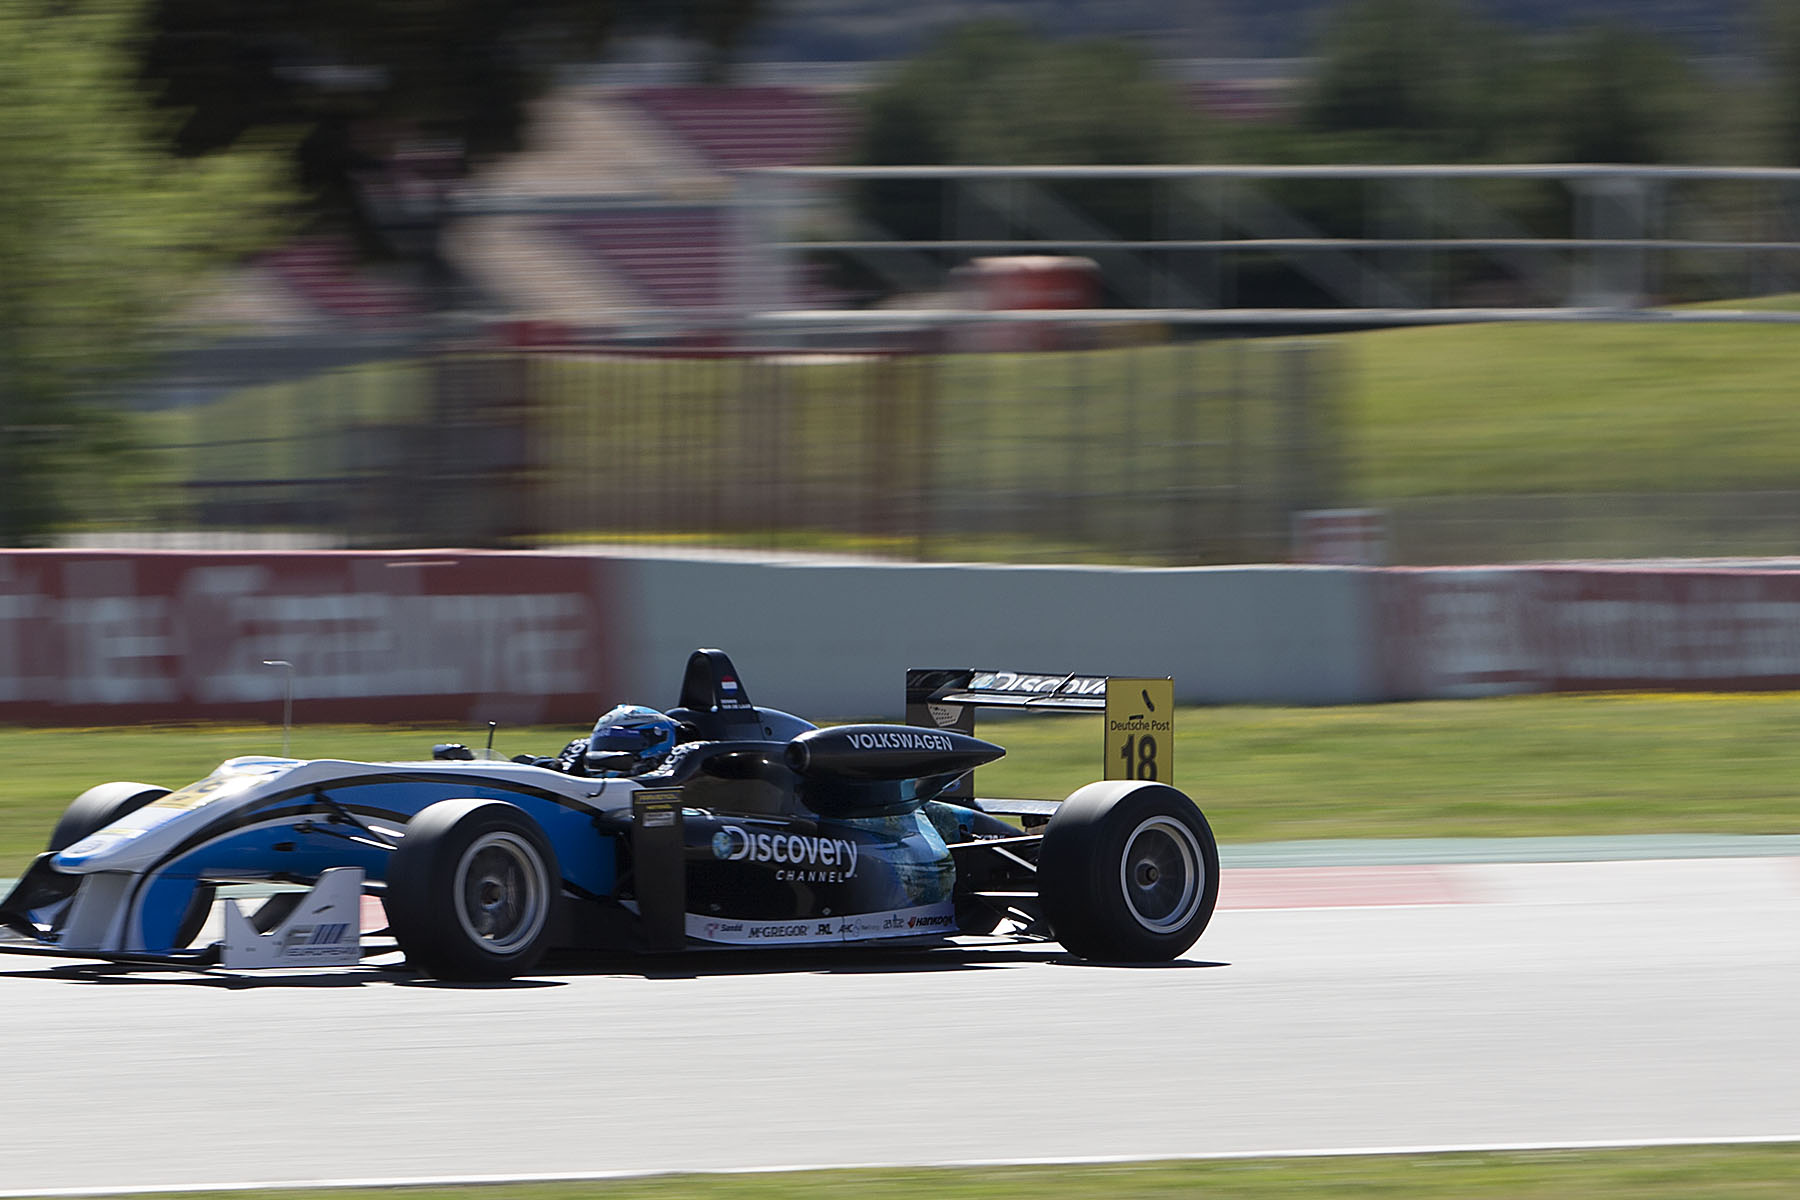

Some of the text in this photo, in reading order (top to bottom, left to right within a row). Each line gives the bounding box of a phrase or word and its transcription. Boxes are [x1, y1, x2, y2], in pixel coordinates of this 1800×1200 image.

[1110, 720, 1170, 731] Deutsche Post
[846, 733, 953, 751] VOLKSWAGEN
[1121, 734, 1158, 781] 18
[721, 825, 857, 878] Discovery
[775, 870, 845, 883] CHANNEL
